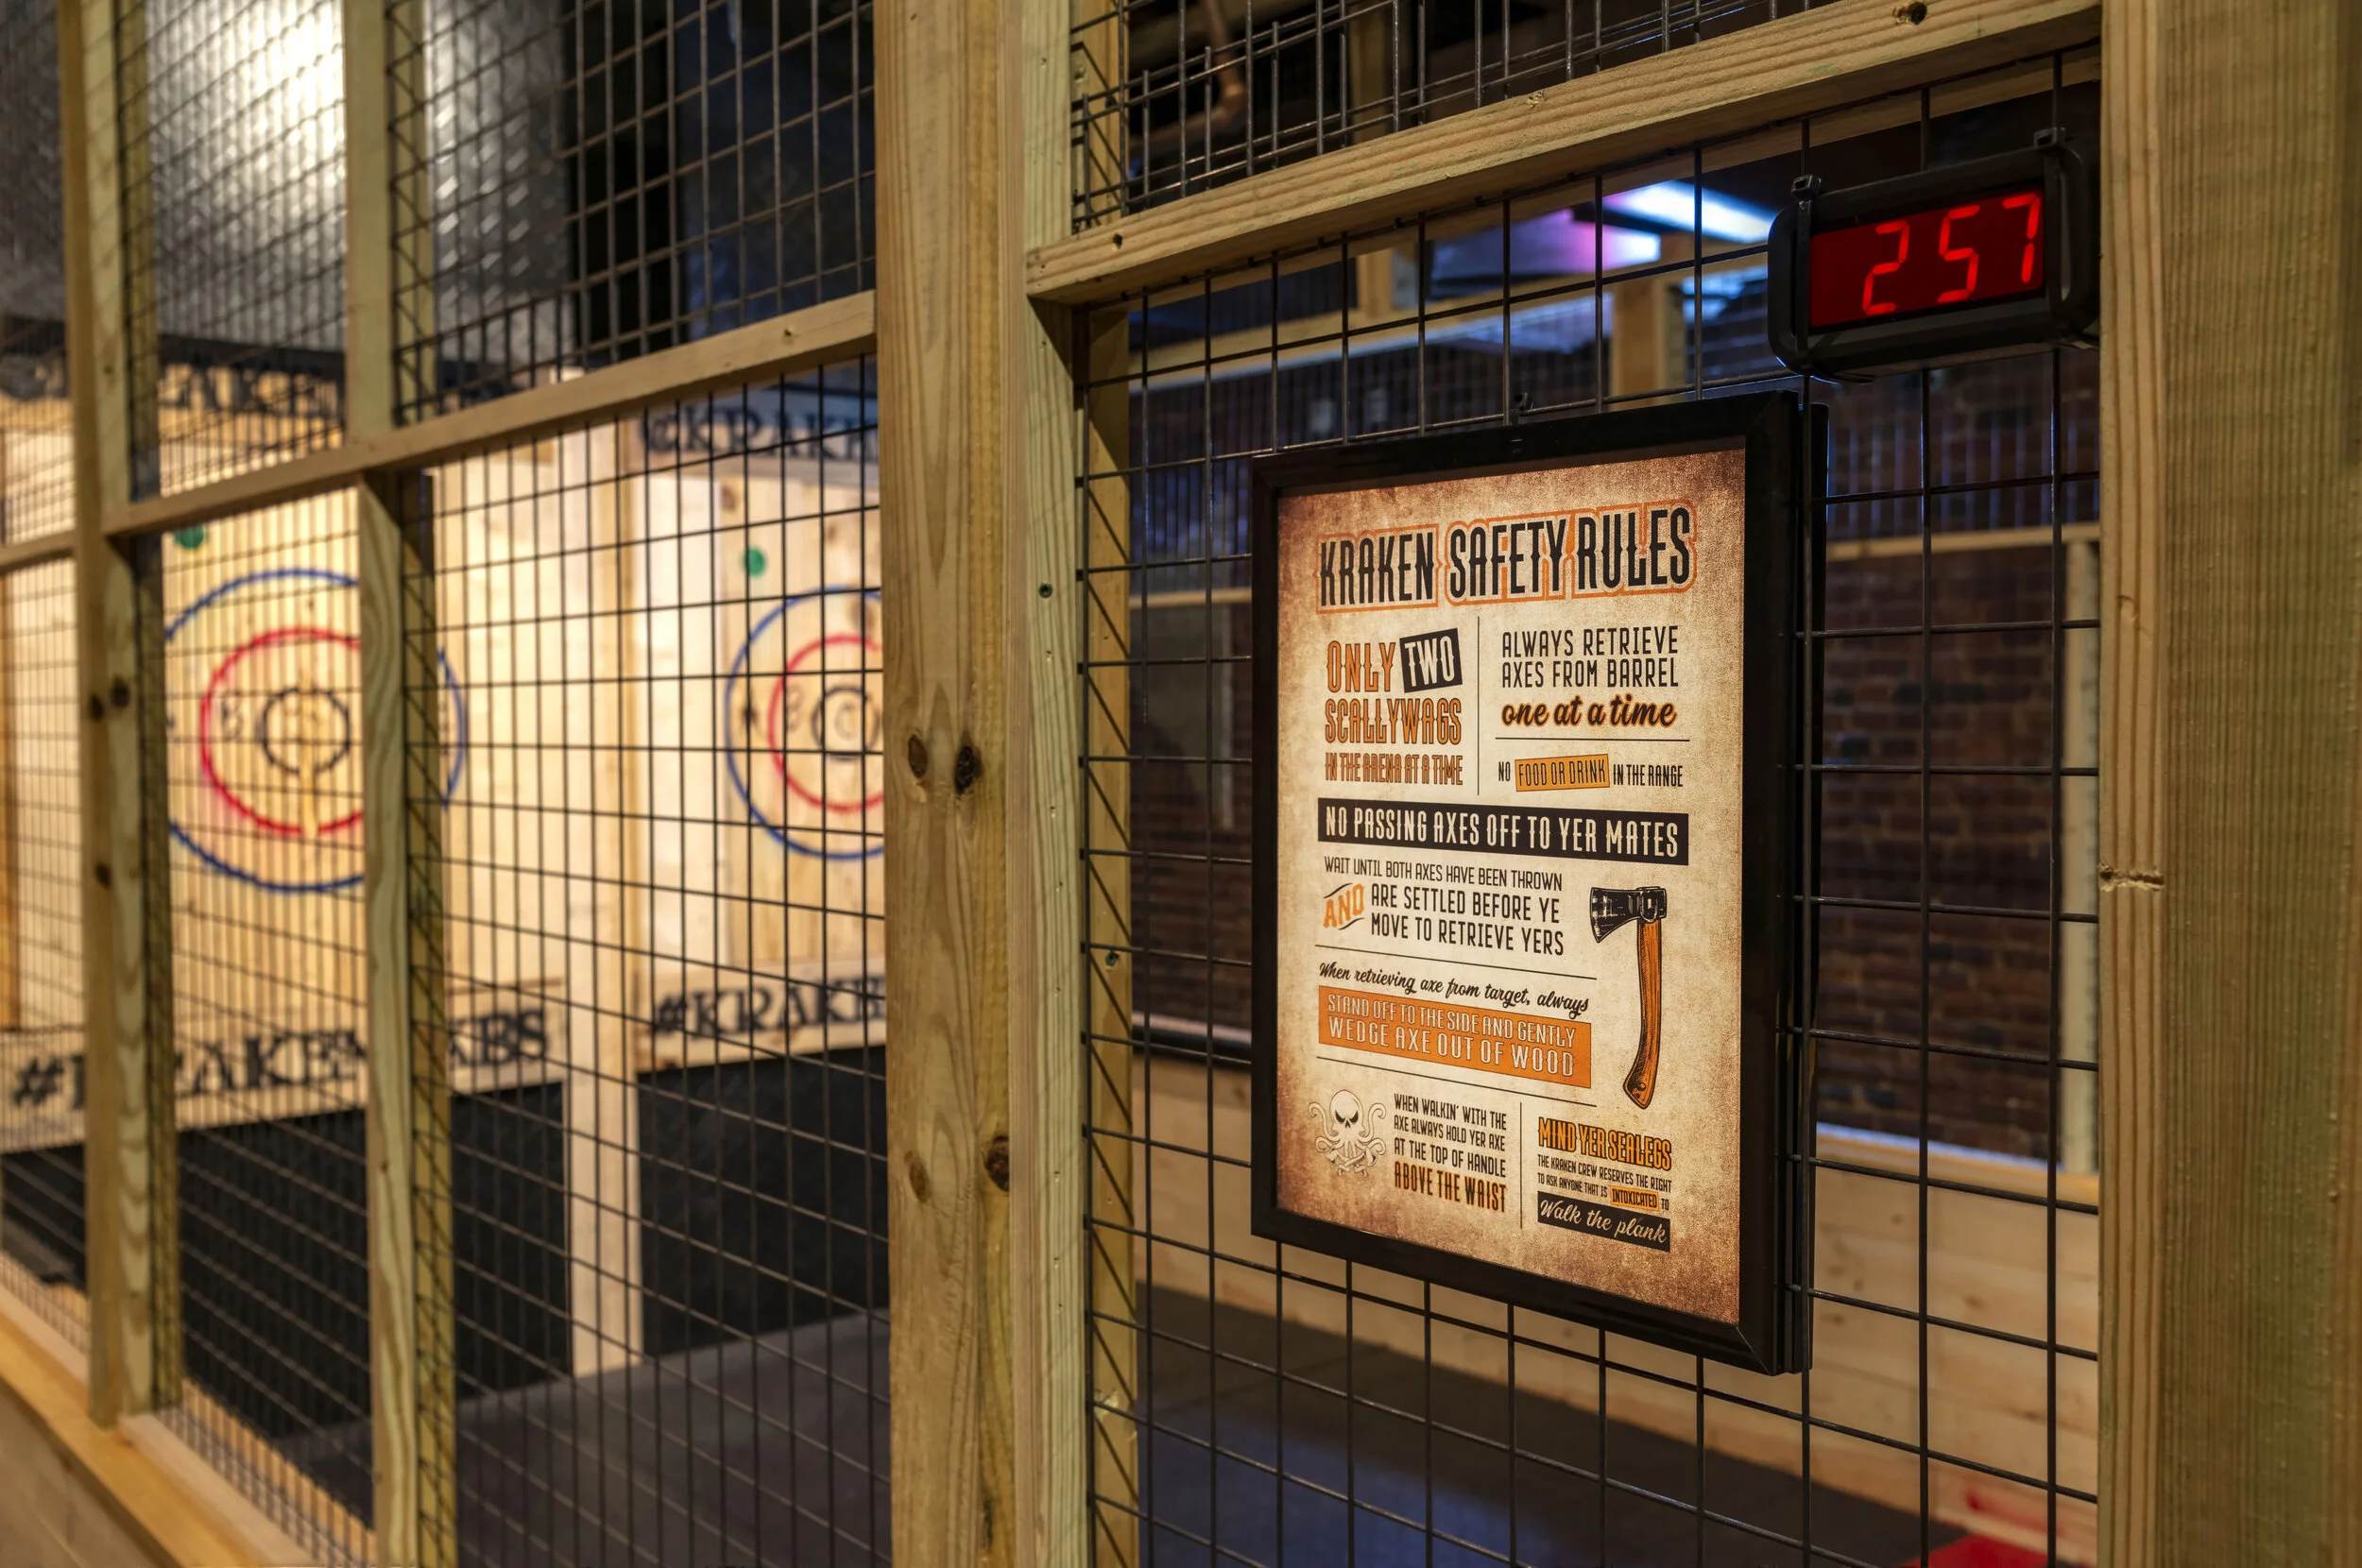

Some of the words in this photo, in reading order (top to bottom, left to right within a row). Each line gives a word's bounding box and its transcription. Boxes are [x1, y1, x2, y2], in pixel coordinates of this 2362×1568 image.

[1320, 532, 1434, 606] KRAKEN
[1449, 519, 1566, 598] SAFETY
[1577, 507, 1690, 589] RULES
[1502, 630, 1574, 657] ALWAYS
[1583, 625, 1679, 656] RETRIEVE
[1326, 640, 1395, 692] ONLY
[1404, 636, 1455, 687] TWO
[1502, 661, 1544, 688] AXES
[1552, 660, 1598, 687] FROM
[1607, 657, 1679, 687] BARREL
[1325, 697, 1462, 744] SCALLYWAGS
[1501, 703, 1549, 726] one
[1553, 694, 1583, 726] at
[1586, 703, 1606, 726] a
[1609, 692, 1678, 728] time
[1325, 752, 1338, 781] IN
[1339, 753, 1361, 782] THE
[1362, 754, 1402, 783] ARENA
[1404, 754, 1420, 784] AT
[1421, 754, 1430, 784] A
[1431, 755, 1463, 786] TIME
[1498, 761, 1511, 782] NO
[1518, 762, 1548, 787] FOOD
[1550, 761, 1566, 785] OR
[1568, 758, 1606, 784] DRINK
[1613, 763, 1624, 786] IN
[1626, 764, 1646, 786] THE
[1648, 764, 1684, 788] RANGE
[1326, 806, 1347, 837] NO
[1354, 807, 1428, 843] PASSING
[1433, 810, 1480, 845] AXES
[1486, 813, 1521, 847] OFF
[1527, 815, 1550, 850] TO
[1558, 817, 1597, 852] YER
[1605, 819, 1678, 858] MATES
[1324, 856, 1351, 875] WAIT
[1353, 859, 1383, 878] UNTIL
[1386, 861, 1412, 879] BOTH
[1416, 862, 1443, 882] AXES
[1446, 864, 1475, 884] HAVE
[1479, 867, 1507, 887] BEEN
[1511, 870, 1563, 892] THROWN
[1323, 883, 1365, 929] AND
[1371, 883, 1397, 909] ARE
[1404, 886, 1465, 914] SETTLED
[1473, 892, 1532, 921] BEFORE
[1539, 896, 1560, 924] YE
[1371, 912, 1409, 939] MOVE
[1414, 916, 1432, 942] TO
[1438, 919, 1514, 951] RETRIEVE
[1521, 927, 1564, 956] YERS
[1319, 962, 1351, 980] When
[1354, 968, 1417, 996] retrieving
[1420, 979, 1444, 993] axe
[1446, 978, 1481, 999] from
[1484, 983, 1531, 1009] target,
[1536, 991, 1589, 1020] always
[1327, 994, 1369, 1017] STAND
[1373, 999, 1397, 1021] OFF
[1399, 1003, 1416, 1025] TO
[1418, 1006, 1445, 1030] THE
[1446, 1011, 1480, 1034] SIDE
[1482, 1015, 1514, 1039] AND
[1517, 1020, 1576, 1048] GENTLY
[1328, 1015, 1390, 1048] WEDGE
[1395, 1026, 1431, 1054] AXE
[1437, 1032, 1474, 1061] OUT
[1480, 1039, 1505, 1065] OF
[1511, 1043, 1575, 1077] WOOD
[1394, 1093, 1418, 1114] WHEN
[1463, 1105, 1487, 1127] WITH
[1489, 1111, 1507, 1131] THE
[1394, 1115, 1409, 1133] AXE
[1412, 1117, 1444, 1139] ALWAYS
[1446, 1124, 1466, 1144] HOLD
[1469, 1129, 1486, 1148] YER
[1489, 1133, 1505, 1151] AXE
[1394, 1137, 1406, 1156] AT
[1409, 1140, 1427, 1161] THE
[1429, 1144, 1448, 1165] TOP
[1451, 1149, 1463, 1168] OF
[1467, 1151, 1506, 1178] HANDLE
[1538, 1116, 1577, 1152] MIND
[1578, 1123, 1607, 1159] YER
[1394, 1161, 1433, 1196] ABOVE
[1436, 1169, 1460, 1202] THE
[1464, 1175, 1507, 1213] WAIST
[1537, 1153, 1549, 1168] THE
[1550, 1156, 1577, 1174] KRAKEN
[1578, 1162, 1598, 1177] CREW
[1599, 1167, 1634, 1185] RESERVES
[1635, 1173, 1649, 1188] THE
[1651, 1176, 1672, 1193] RIGHT
[1537, 1172, 1545, 1185] TO
[1546, 1174, 1558, 1187] ASK
[1559, 1177, 1583, 1193] ANYONE
[1584, 1182, 1600, 1196] THAT
[1600, 1185, 1608, 1198] IS
[1612, 1188, 1657, 1208] INTOXICATED
[1661, 1198, 1669, 1211] TO
[1540, 1199, 1582, 1225] Walk
[1586, 1210, 1612, 1231] the
[1614, 1218, 1668, 1244] plank
